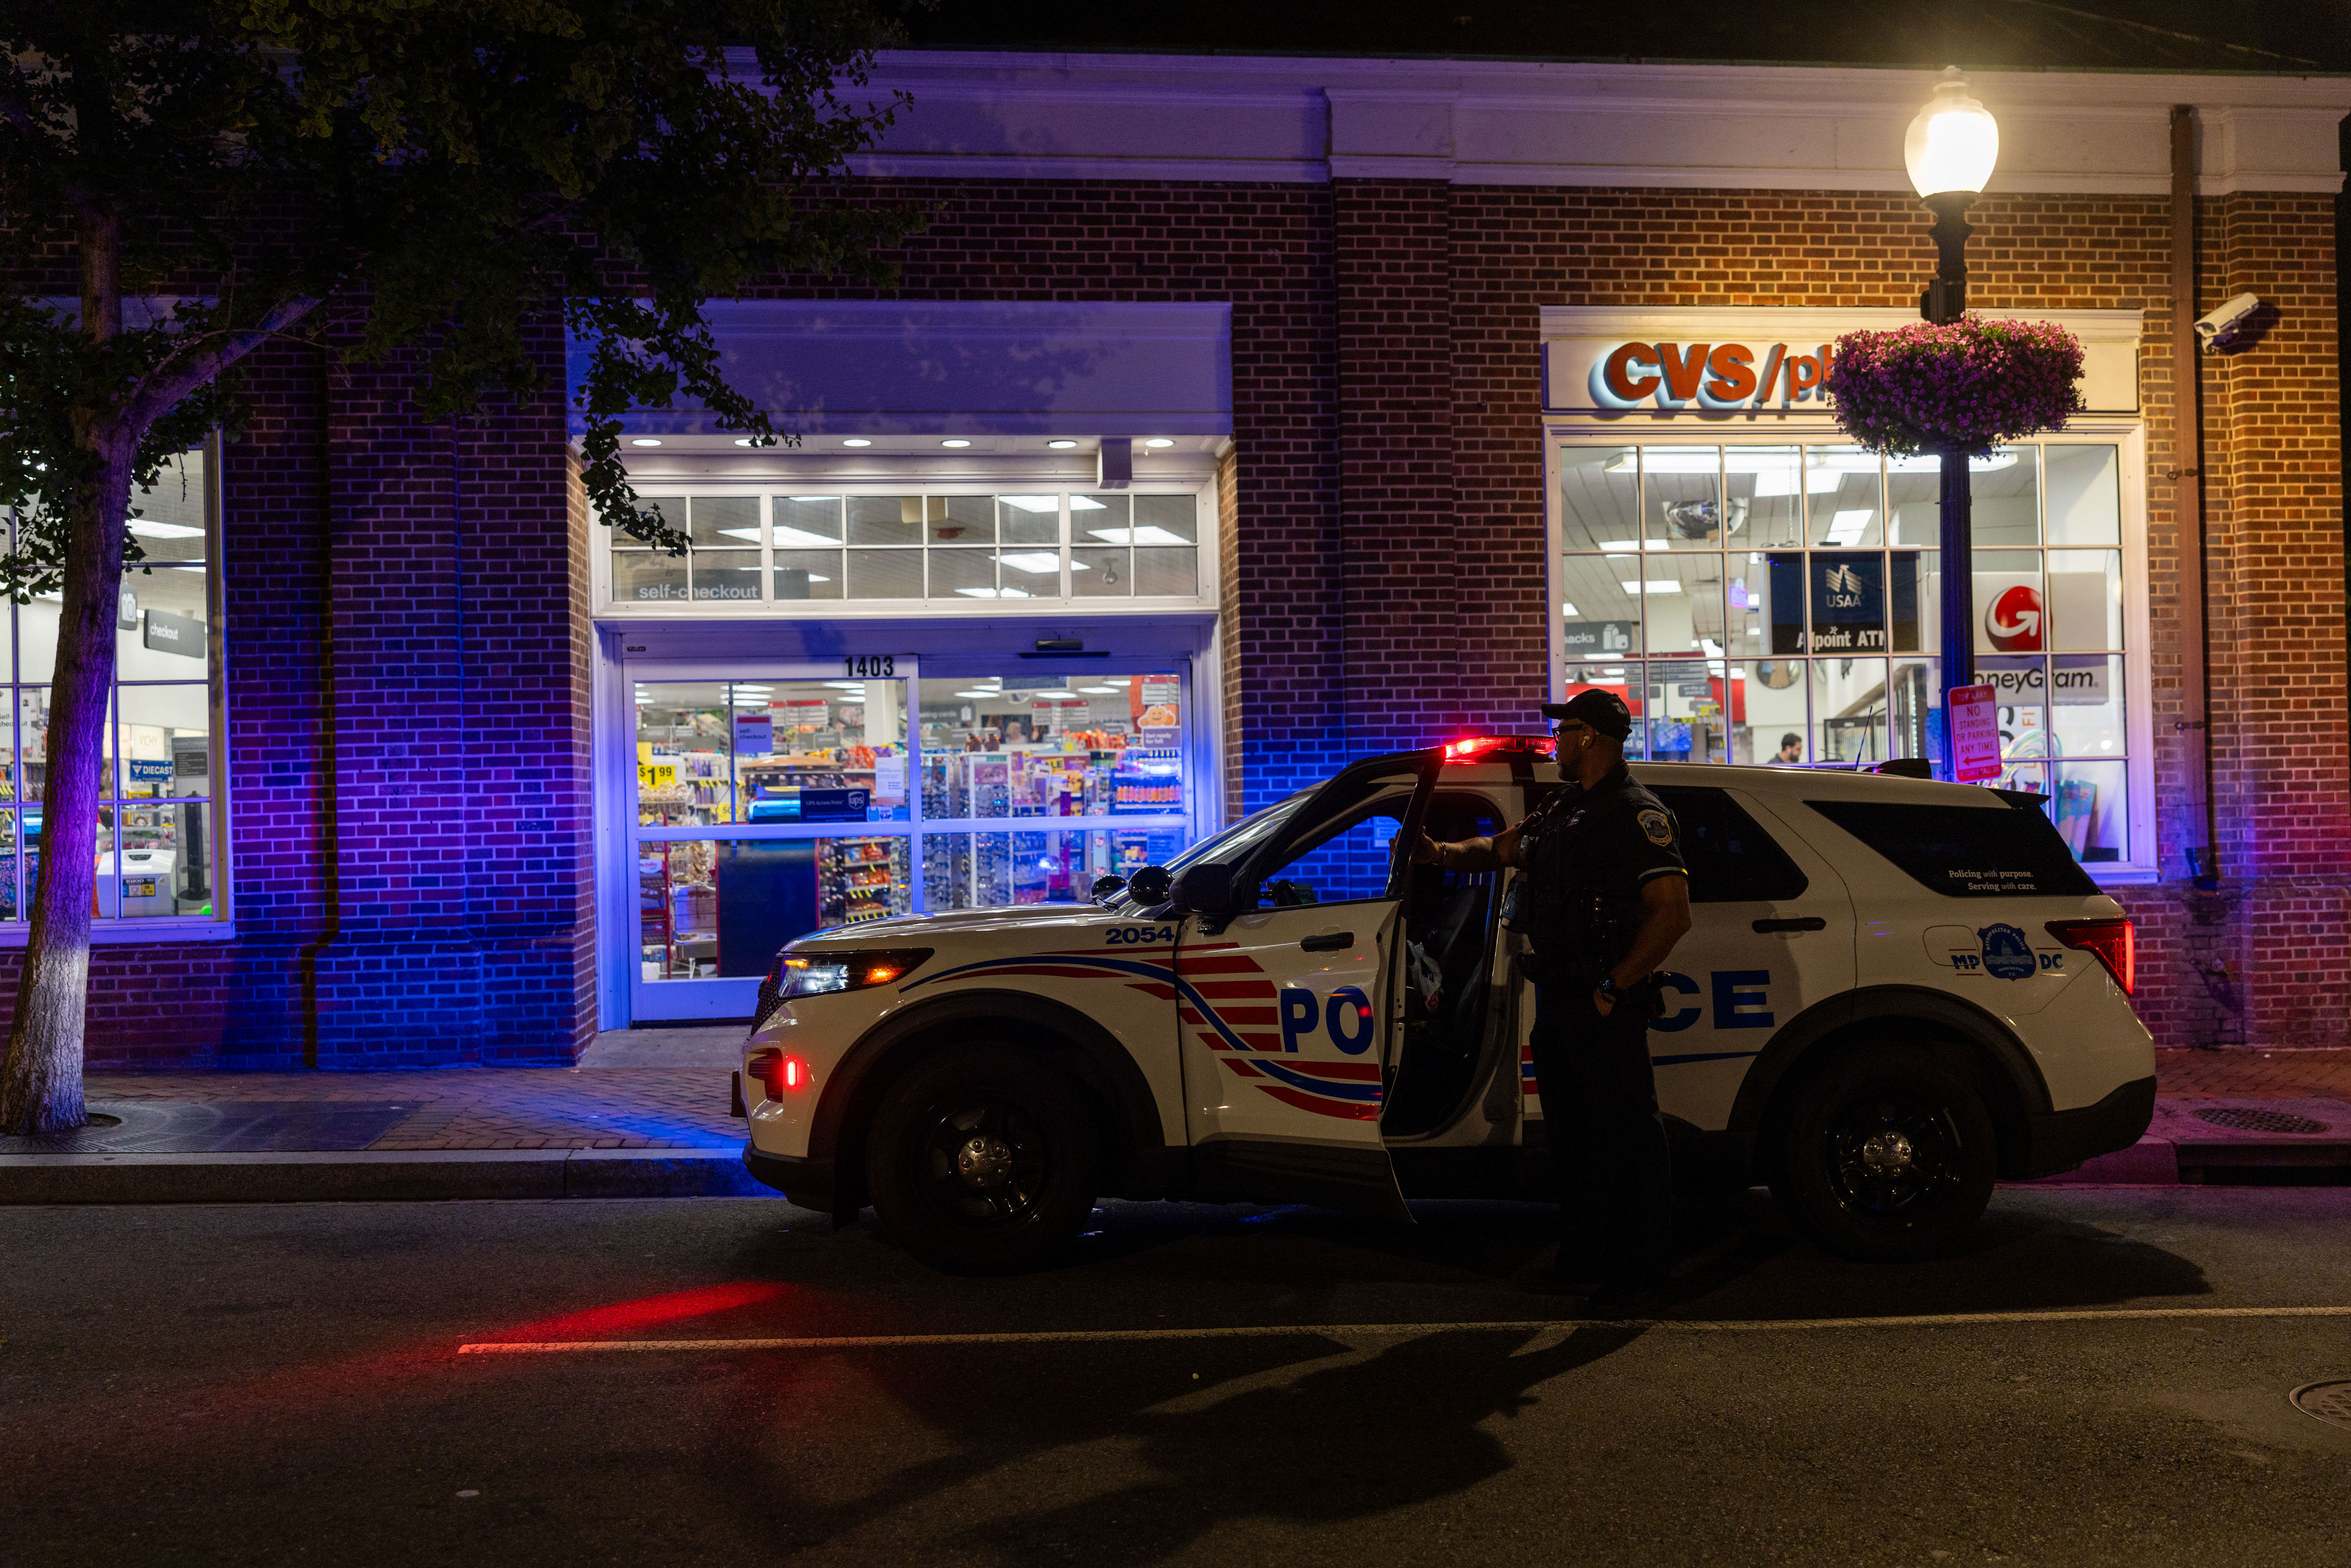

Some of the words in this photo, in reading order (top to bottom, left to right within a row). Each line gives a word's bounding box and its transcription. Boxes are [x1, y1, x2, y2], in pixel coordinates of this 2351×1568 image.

[1826, 594, 1862, 608] USAA
[150, 622, 179, 641] checkout
[845, 656, 895, 677] 1403
[1967, 704, 1980, 717] NO
[1959, 717, 1990, 729] STANDING
[140, 733, 158, 747] VICHY
[1957, 733, 1965, 742] OR
[1967, 729, 1995, 741] PARKING
[1961, 743, 1974, 755] ANY
[1977, 741, 1994, 752] TIME
[143, 765, 173, 775] DIECAST
[849, 797, 864, 807] ups
[1948, 870, 1981, 879] Policing
[1999, 871, 2034, 879] purpose.
[1967, 882, 2000, 892] Serving
[2000, 882, 2016, 890] with
[1105, 926, 1175, 945] 2054
[1985, 927, 2011, 951] METROPOLITAN
[2012, 933, 2027, 951] POLICE
[1951, 955, 1980, 970] MP
[2039, 954, 2064, 970] DC
